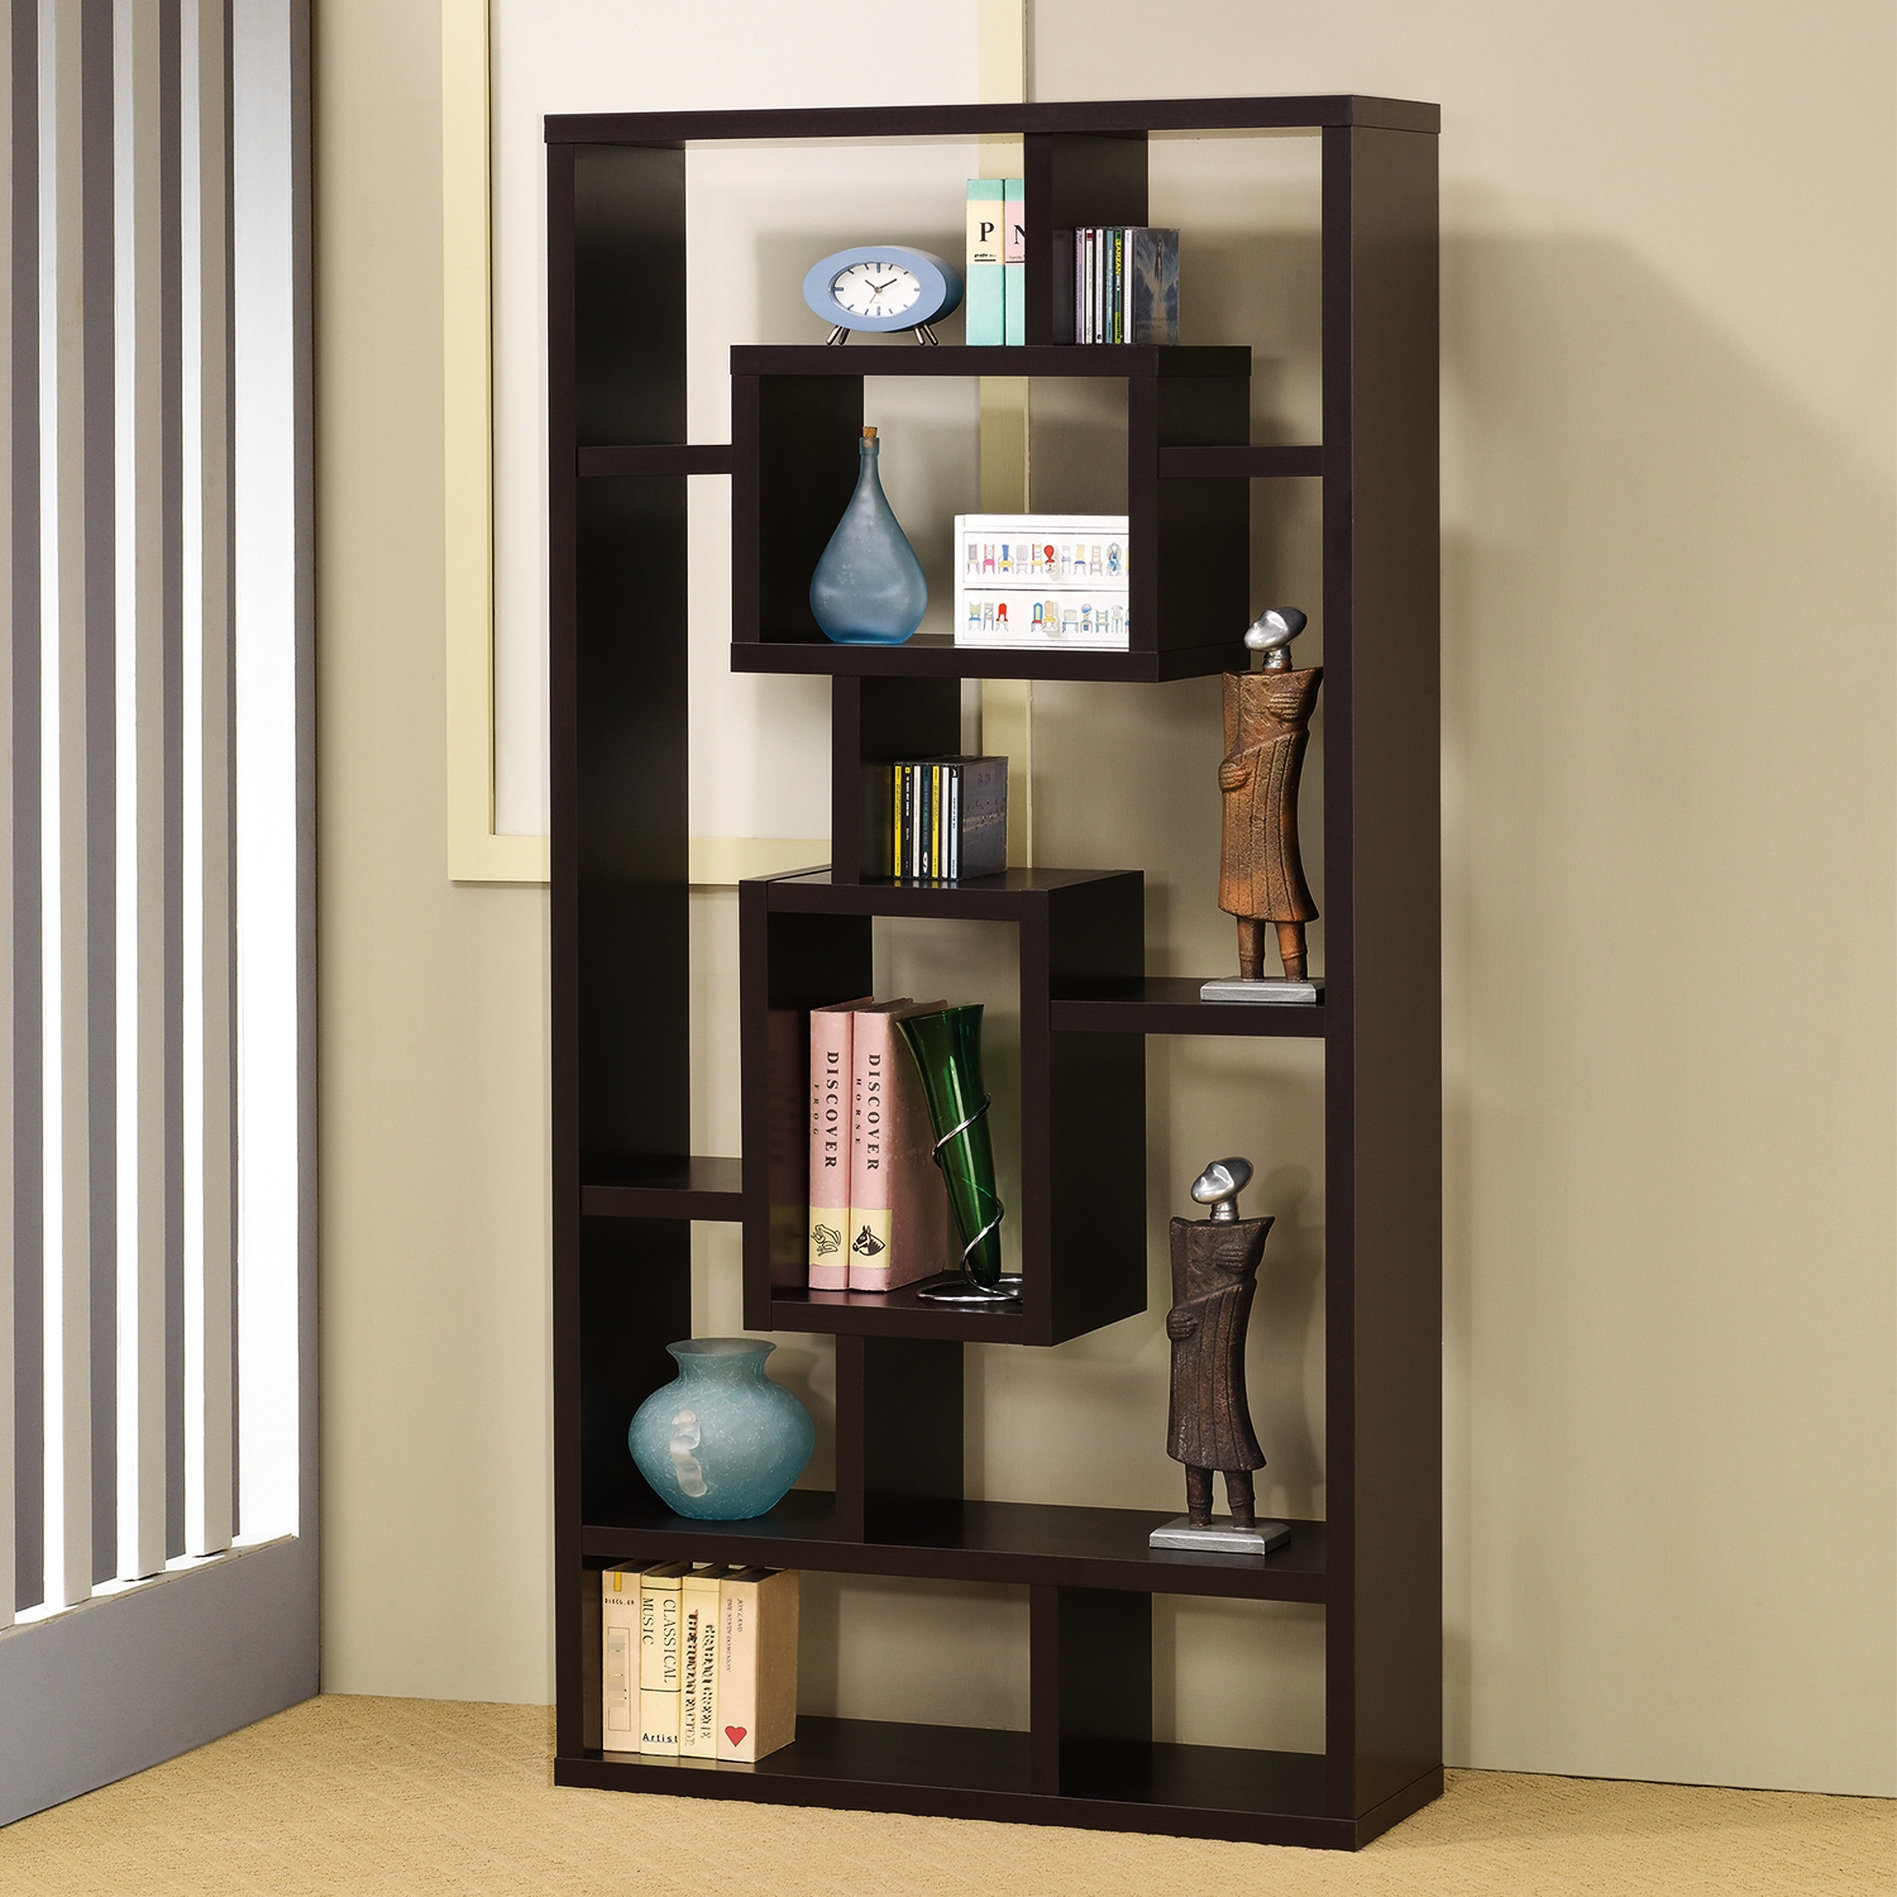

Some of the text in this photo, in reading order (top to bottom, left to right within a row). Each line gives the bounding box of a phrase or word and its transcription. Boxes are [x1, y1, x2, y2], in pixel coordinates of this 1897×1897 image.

[979, 221, 995, 243] P
[824, 1051, 840, 1168] DISCOVER
[866, 1054, 881, 1171] DISCOVER
[642, 1597, 654, 1646] MUSIC
[663, 1599, 677, 1684] CLASSICAL
[642, 1733, 679, 1744] Artist
